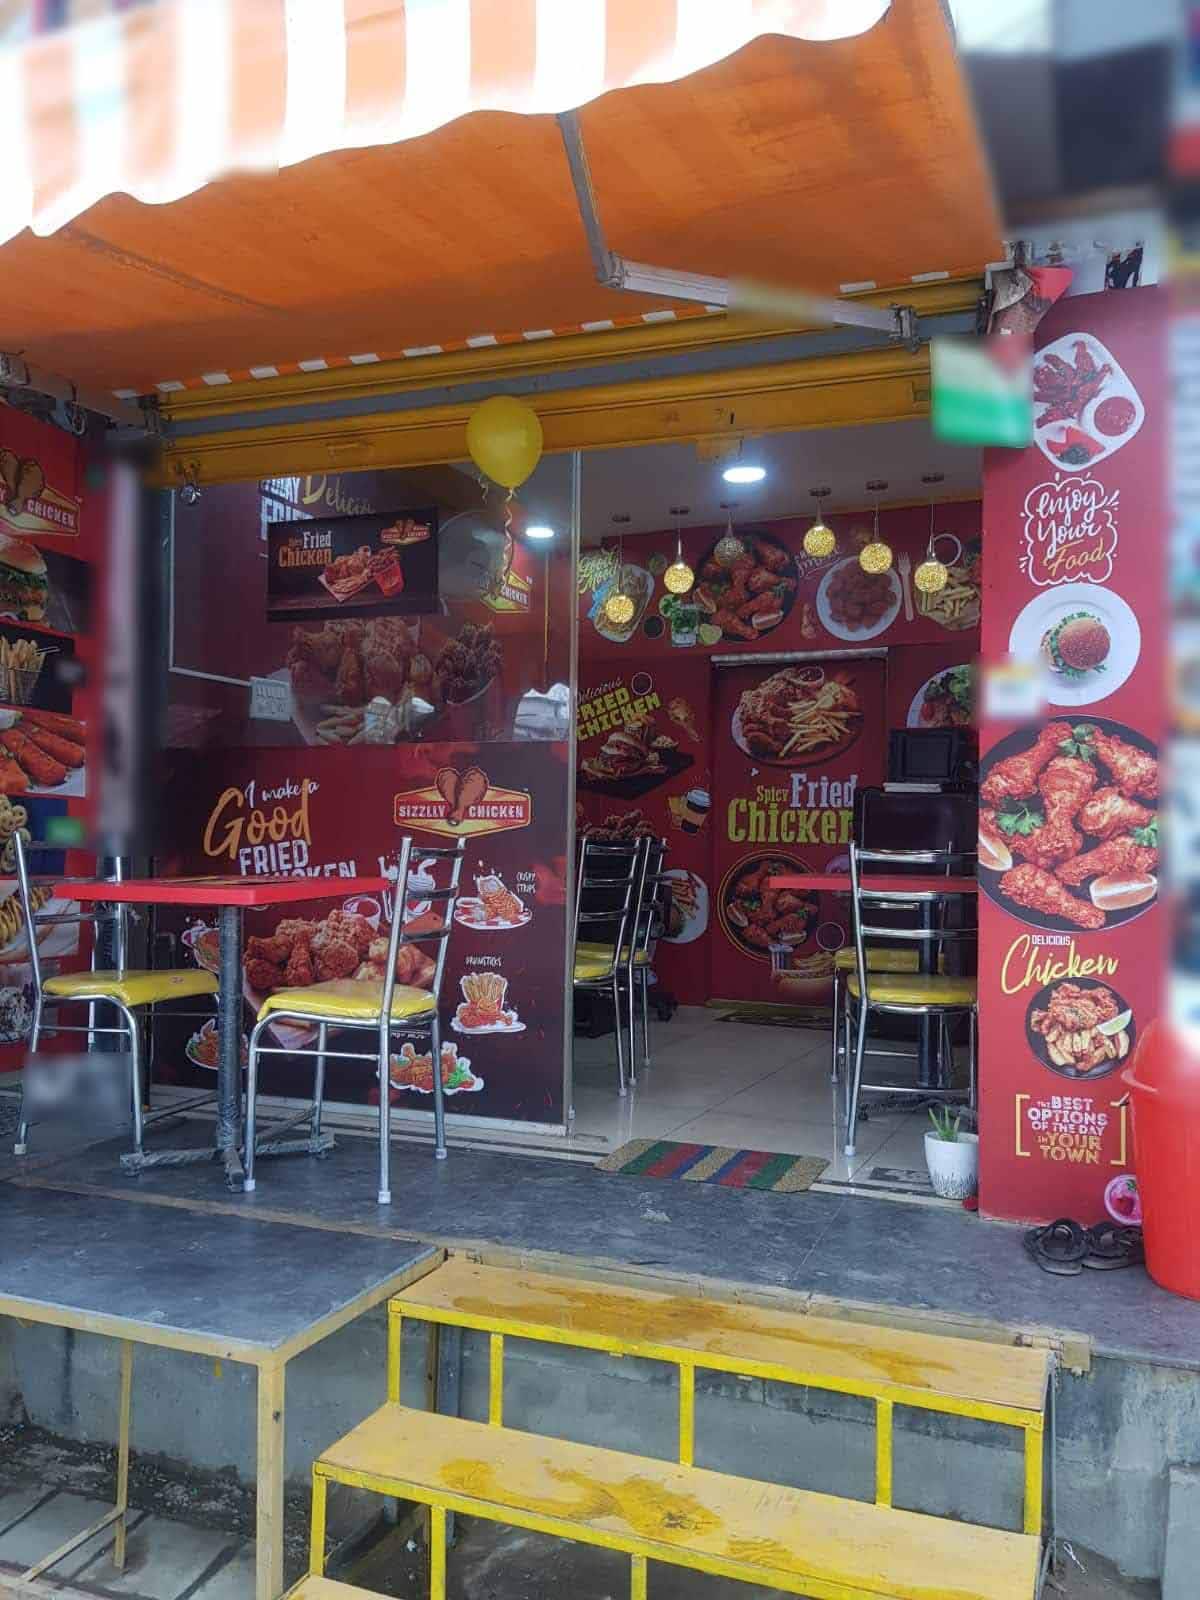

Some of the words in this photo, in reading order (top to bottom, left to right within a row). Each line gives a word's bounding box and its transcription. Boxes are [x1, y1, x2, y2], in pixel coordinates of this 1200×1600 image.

[1038, 519, 1102, 559] Your
[1043, 538, 1106, 577] Food
[262, 779, 299, 801] make
[307, 782, 320, 794] a
[790, 771, 858, 808] Fried
[204, 778, 312, 860] Good
[468, 804, 524, 818] CHICKEN
[240, 839, 309, 876] FRIED
[1031, 934, 1071, 946] DELICIOUS
[1001, 934, 1119, 995] Chicken
[1051, 1096, 1094, 1111] BEST
[1027, 1107, 1109, 1126] OPTIONS
[1031, 1121, 1049, 1131] OF
[1051, 1122, 1076, 1133] THE
[1079, 1125, 1105, 1137] DAY
[1047, 1132, 1103, 1151] YOUR
[1039, 1145, 1100, 1164] TOWN
